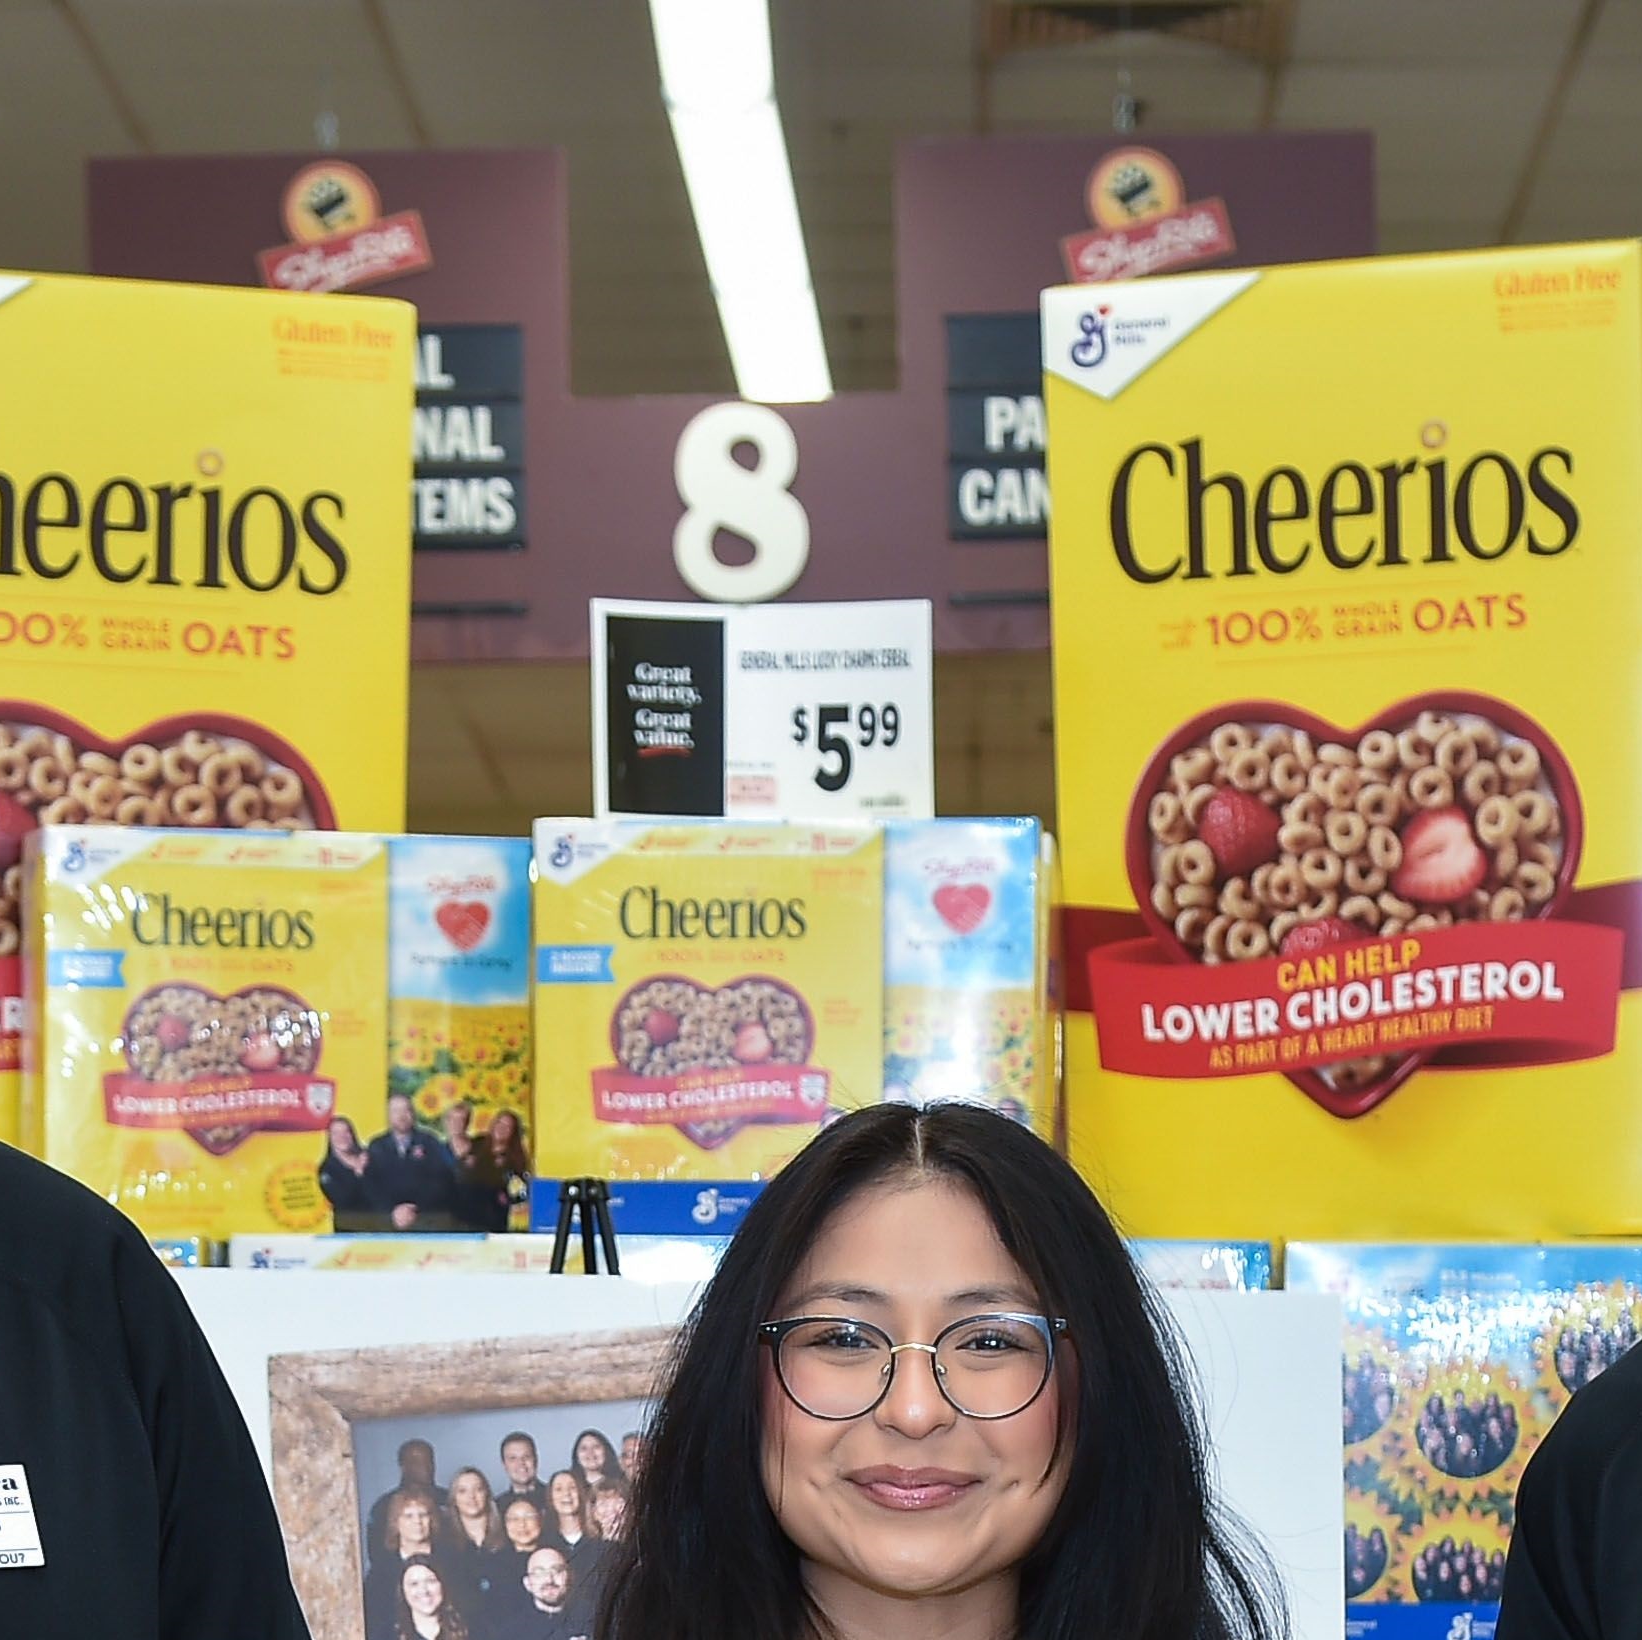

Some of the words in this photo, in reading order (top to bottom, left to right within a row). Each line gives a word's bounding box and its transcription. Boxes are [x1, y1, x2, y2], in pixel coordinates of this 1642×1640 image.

[983, 396, 1046, 452] PA
[673, 401, 811, 602] 8
[1109, 420, 1580, 585] Cheerios
[1207, 608, 1323, 647] 100%
[1414, 594, 1526, 632] OATS
[635, 662, 692, 686] Great
[635, 709, 692, 730] Great
[1277, 954, 1339, 991] CAN
[1345, 939, 1421, 978] HELP
[1141, 993, 1279, 1041] LOWER
[1288, 962, 1564, 1029] CHOLESTEROL
